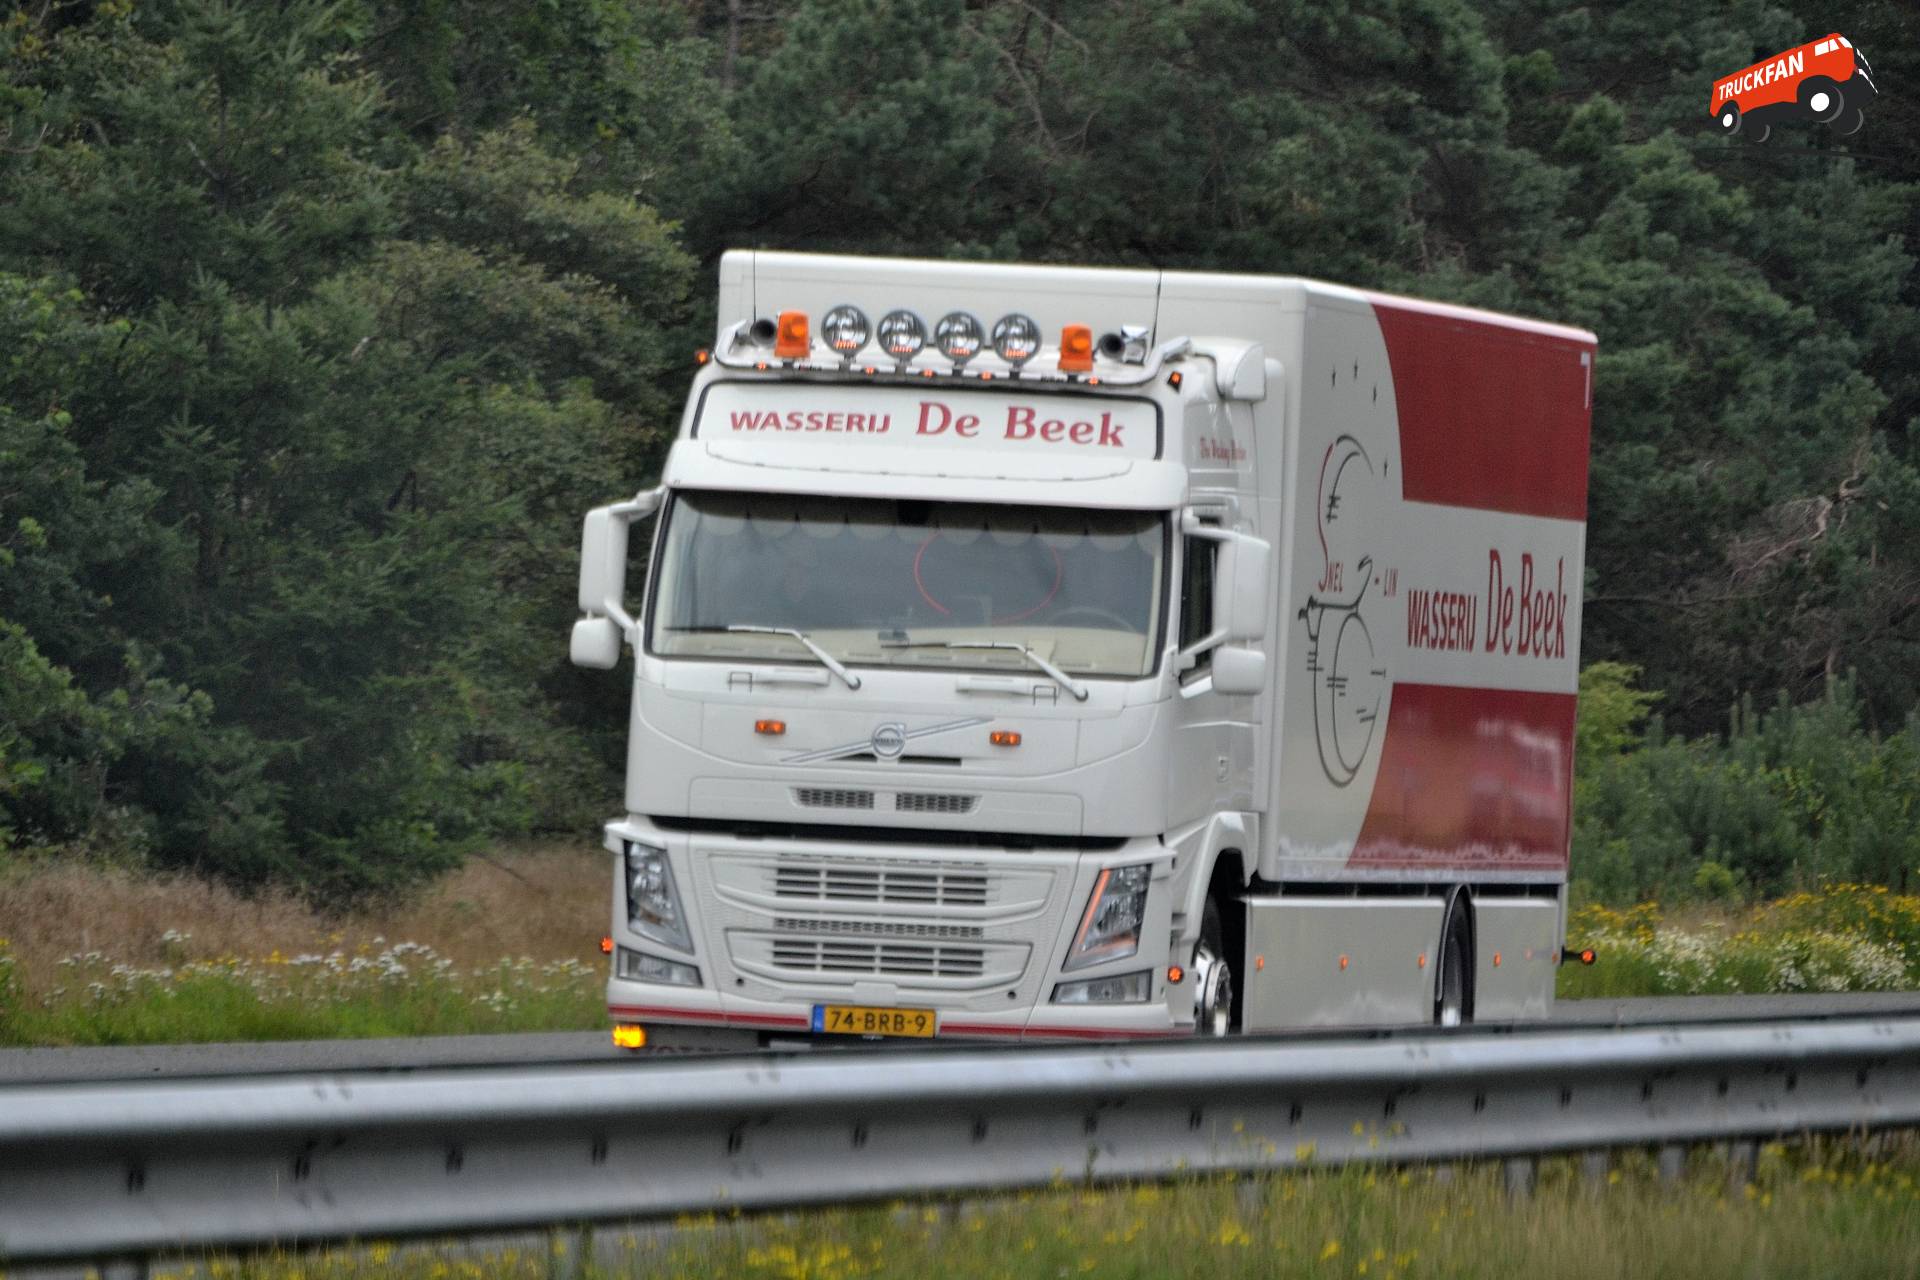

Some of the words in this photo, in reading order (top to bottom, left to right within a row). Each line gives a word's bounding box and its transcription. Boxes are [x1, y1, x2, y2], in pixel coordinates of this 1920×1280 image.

[730, 411, 891, 434] WASSERIJ
[915, 402, 980, 438] De
[1003, 405, 1125, 447] Beek
[1407, 589, 1477, 653] WASSERIJ
[1485, 548, 1514, 656] De
[1517, 552, 1567, 659] Beek
[830, 1011, 926, 1033] 74-BRB-9
